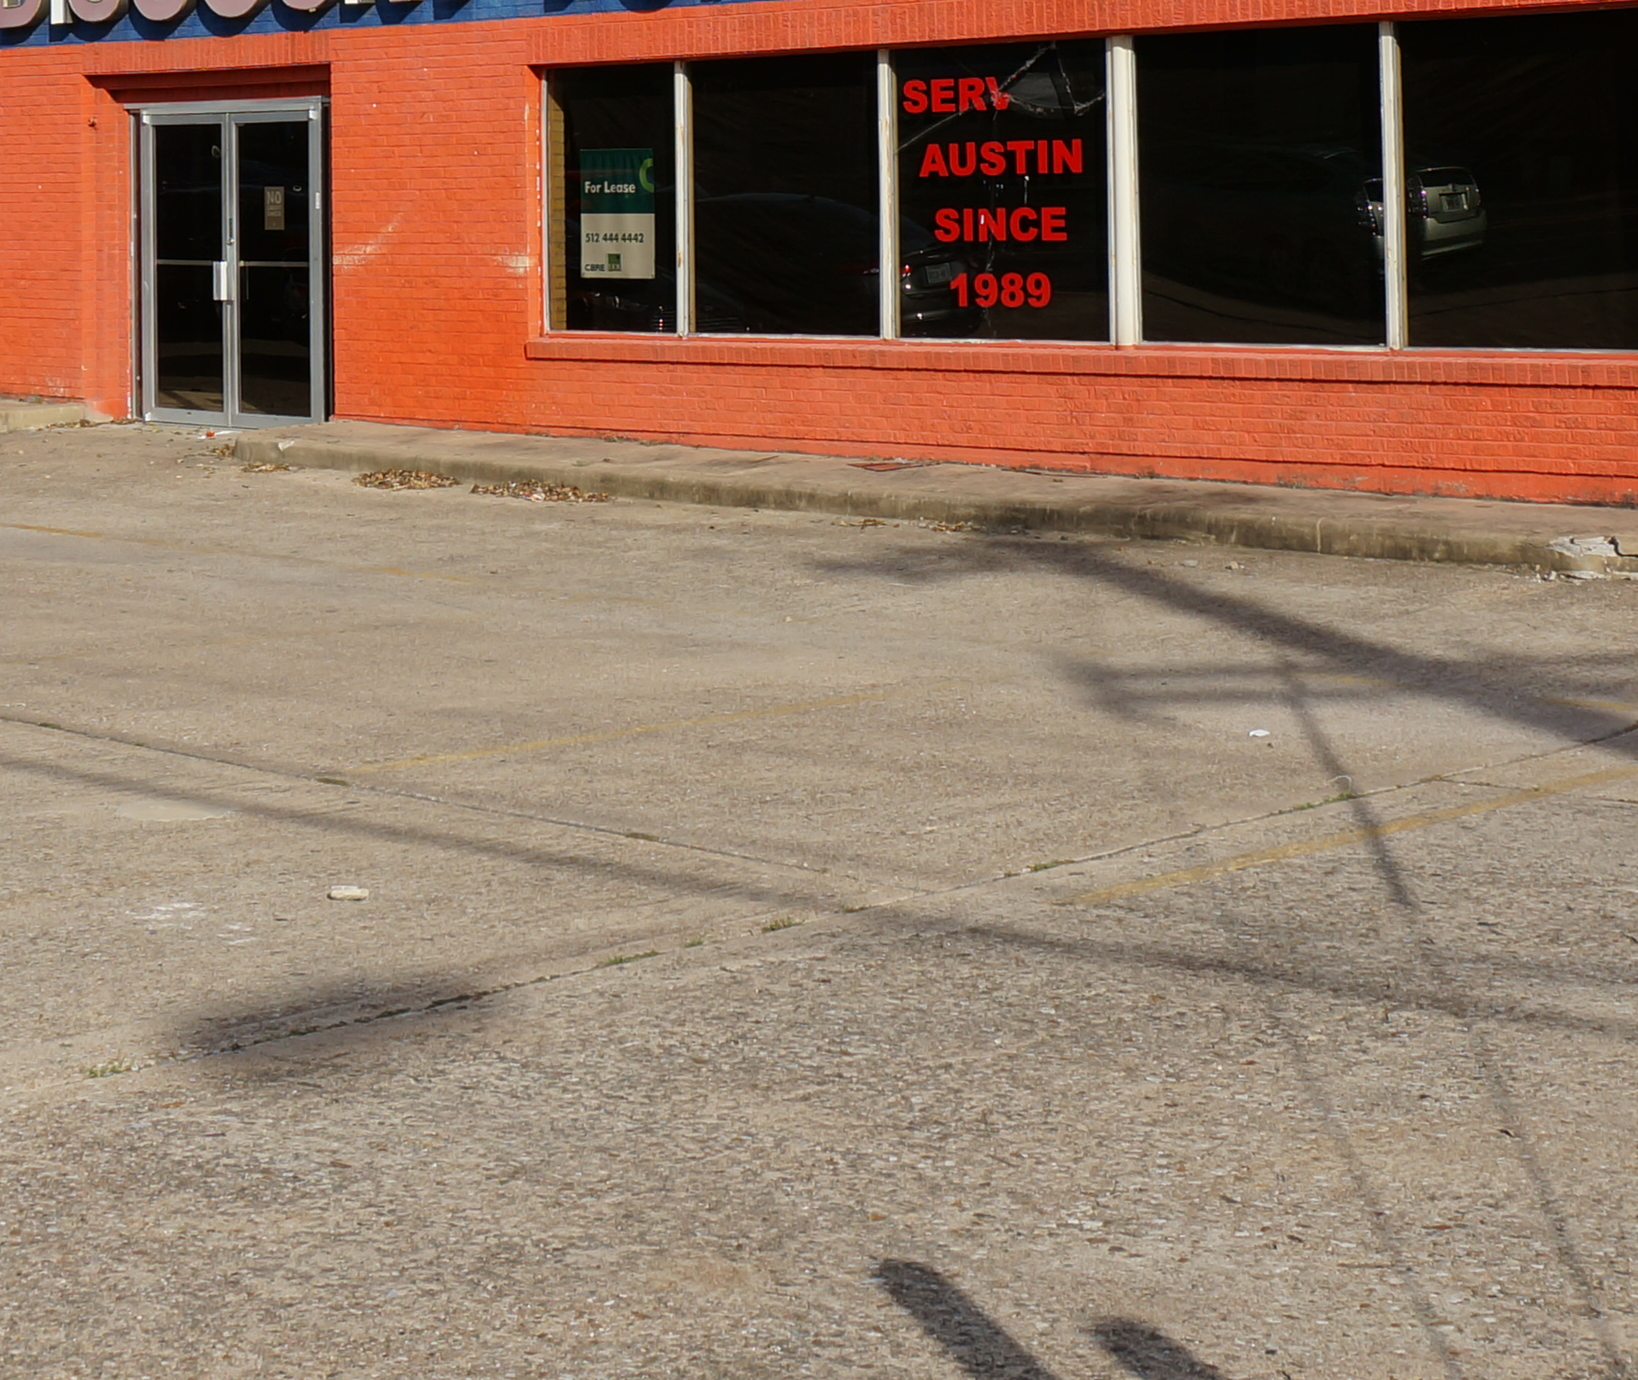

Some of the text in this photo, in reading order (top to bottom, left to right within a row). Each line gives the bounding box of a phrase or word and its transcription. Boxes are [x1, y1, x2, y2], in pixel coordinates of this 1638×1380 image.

[919, 139, 1083, 177] AUSTIN
[266, 190, 282, 205] NO
[584, 181, 636, 194] For Lease
[935, 207, 1068, 242] SINCE
[585, 233, 645, 243] 512 444 4442
[950, 272, 1052, 309] 1989
